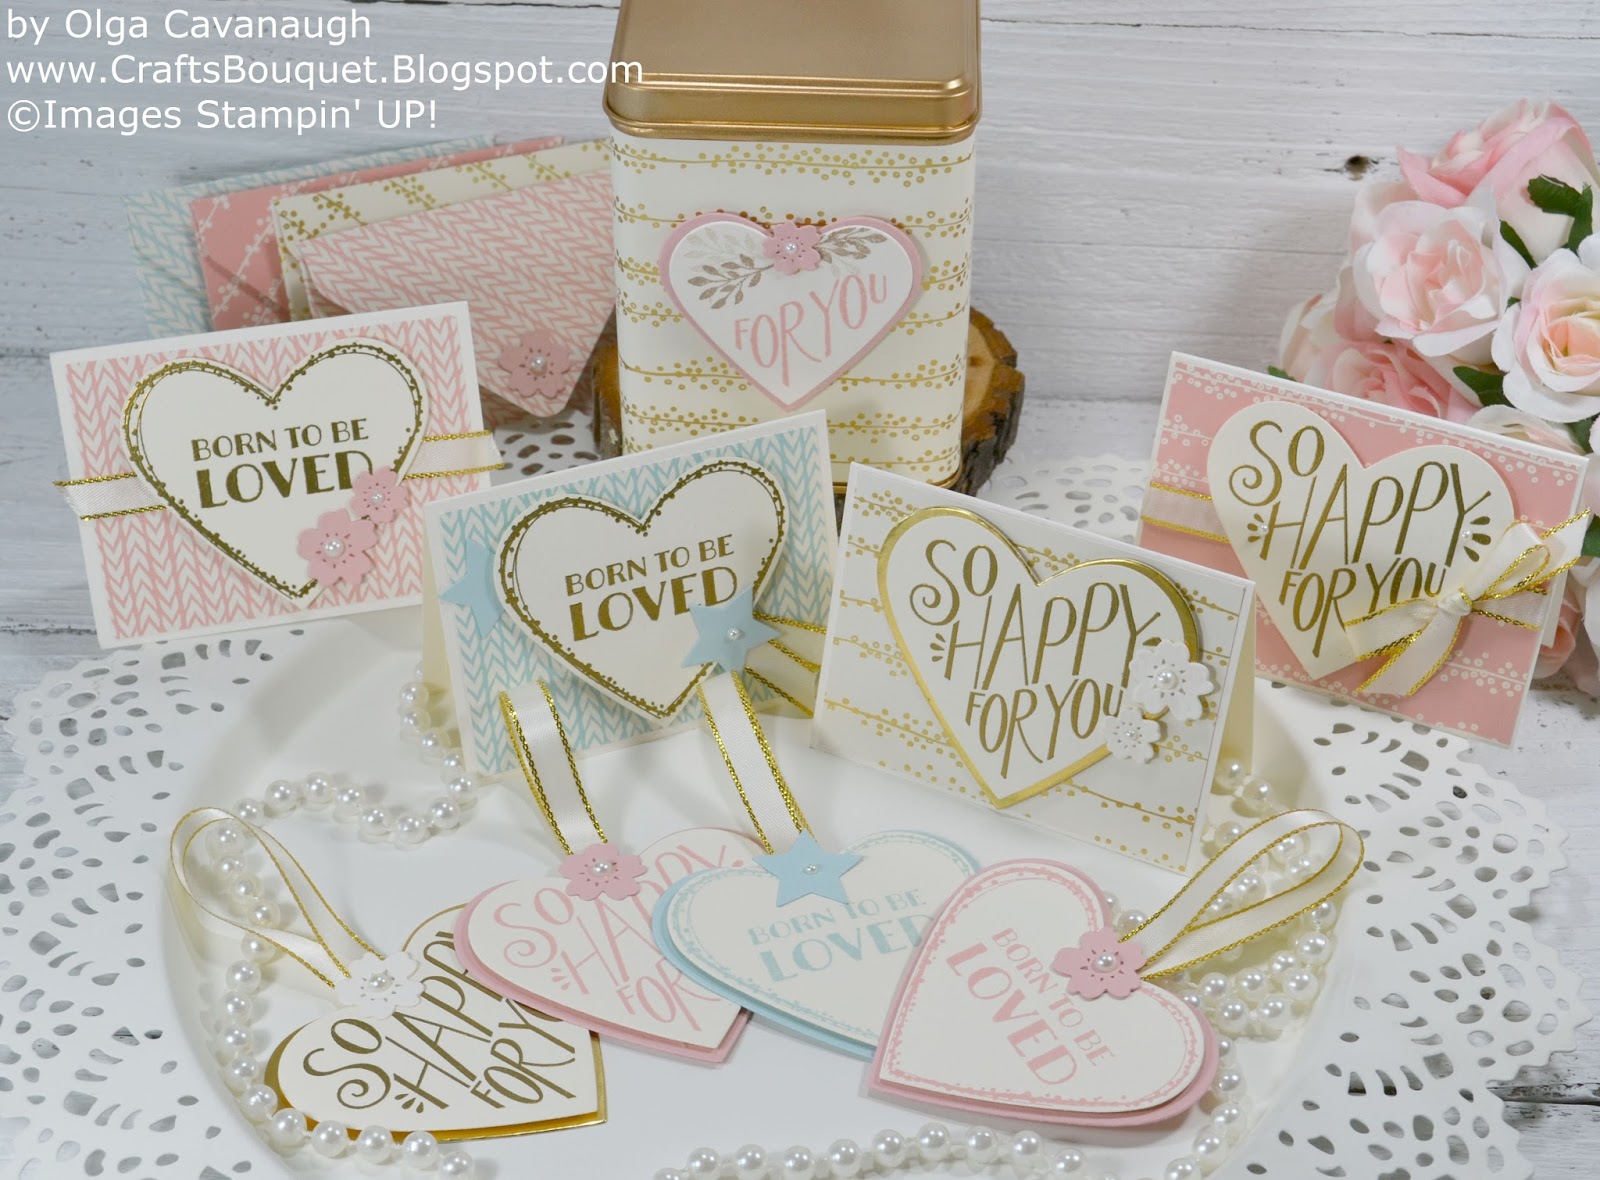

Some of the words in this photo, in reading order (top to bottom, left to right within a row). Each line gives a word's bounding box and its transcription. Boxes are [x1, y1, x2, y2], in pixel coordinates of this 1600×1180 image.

[735, 301, 822, 387] FOR
[809, 273, 887, 358] YOU
[191, 429, 277, 462] BORN
[284, 424, 322, 449] TO
[331, 418, 369, 444] BE
[196, 450, 373, 509] LOVED
[1228, 420, 1325, 507] SO
[1259, 460, 1492, 570] HAPPY
[565, 556, 647, 597] BORN
[654, 546, 691, 573] TO
[698, 533, 734, 562] BE
[569, 566, 738, 642] LOVED
[909, 539, 998, 626] SO
[1279, 568, 1357, 658] FOR
[1365, 557, 1447, 613] YOU
[943, 581, 1161, 691] HAPPY
[965, 688, 1043, 779] FOR
[1044, 678, 1124, 761] YOU
[493, 887, 575, 969] SO
[748, 907, 836, 946] BORN
[844, 898, 880, 920] TO
[884, 889, 928, 913] BE
[759, 914, 935, 983] LOVED
[384, 931, 504, 1110] HAPP
[616, 957, 722, 1032] FOR
[945, 942, 1078, 1086] LOVED
[991, 927, 1058, 995] BORN
[1048, 993, 1084, 1029] TO
[1073, 1029, 1116, 1067] BE
[303, 1018, 392, 1110] SO
[470, 1038, 577, 1109] FOR
